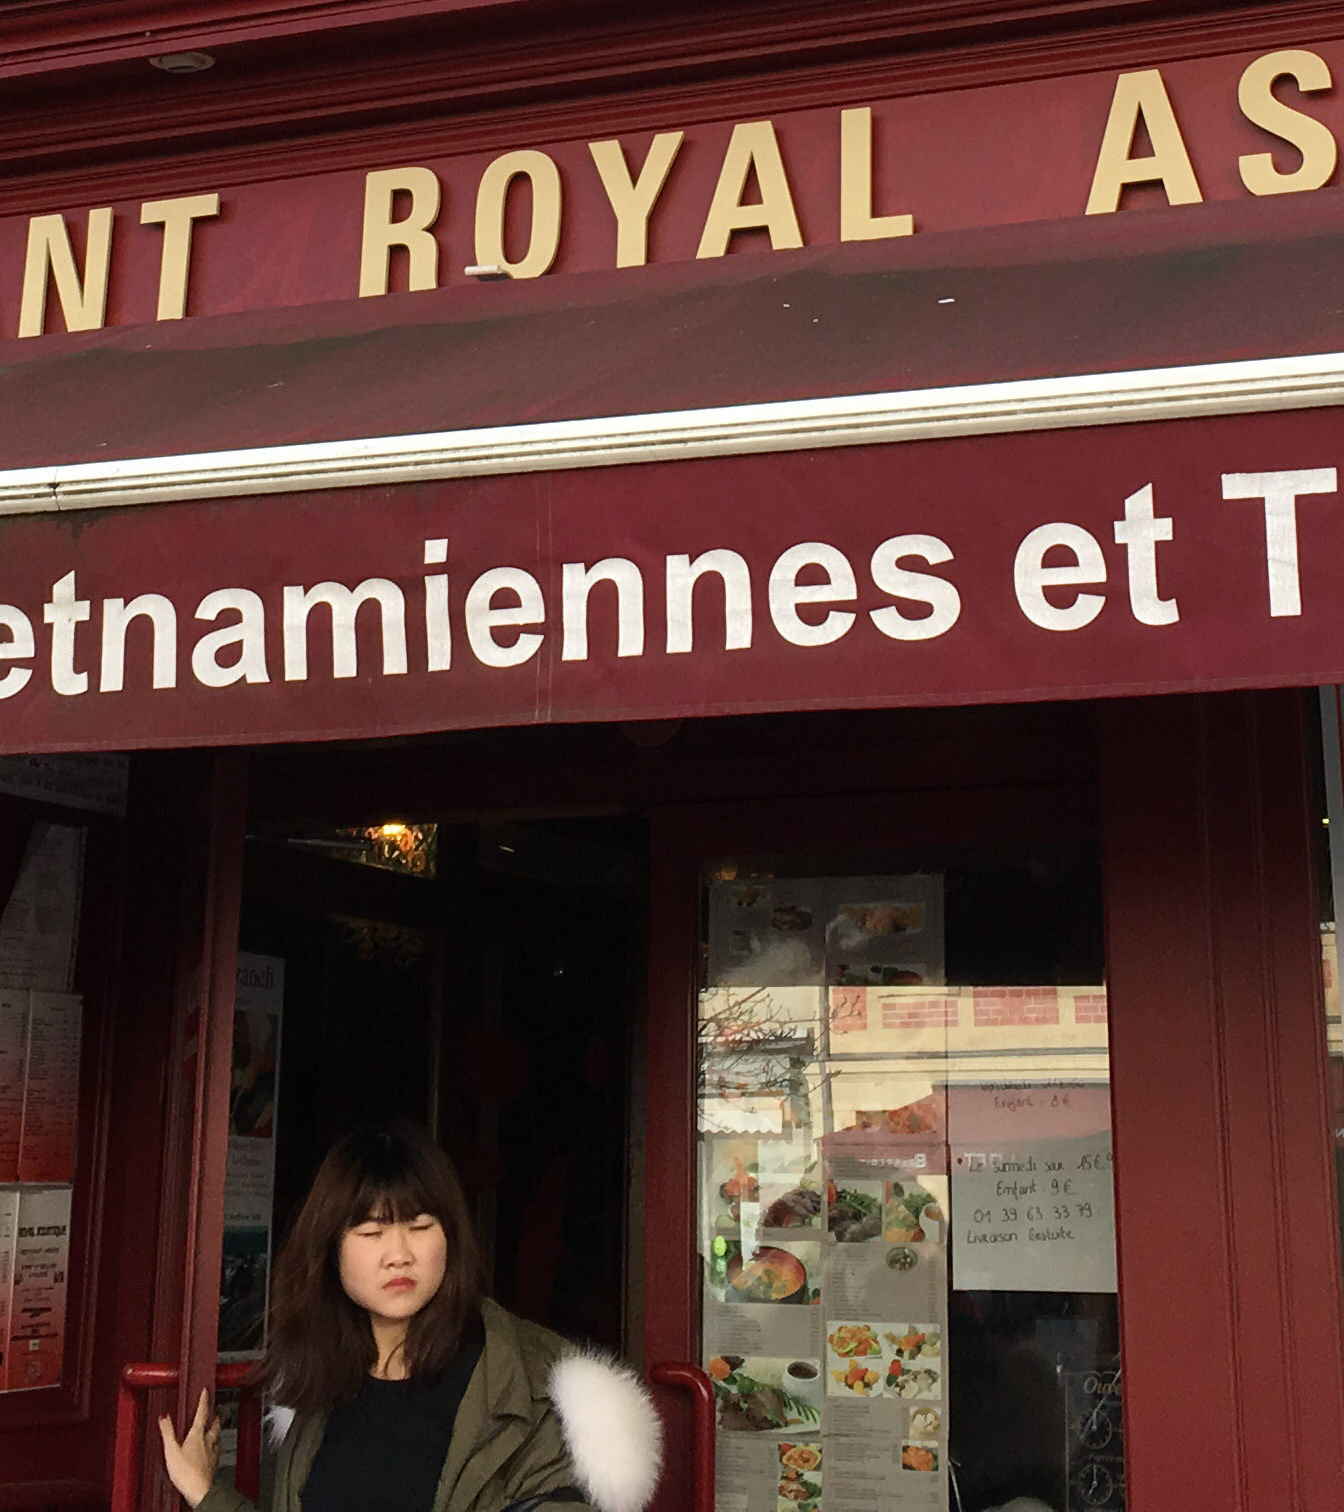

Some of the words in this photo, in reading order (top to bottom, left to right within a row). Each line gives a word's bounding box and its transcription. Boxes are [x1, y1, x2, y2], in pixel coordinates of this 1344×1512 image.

[358, 106, 914, 298] ROYAL
[1013, 482, 1180, 632] et
[973, 1208, 992, 1223] 01
[1001, 1207, 1018, 1222] 39
[1027, 1206, 1043, 1221] 63
[1053, 1205, 1070, 1220] 33
[996, 1178, 1036, 1200] Enfant
